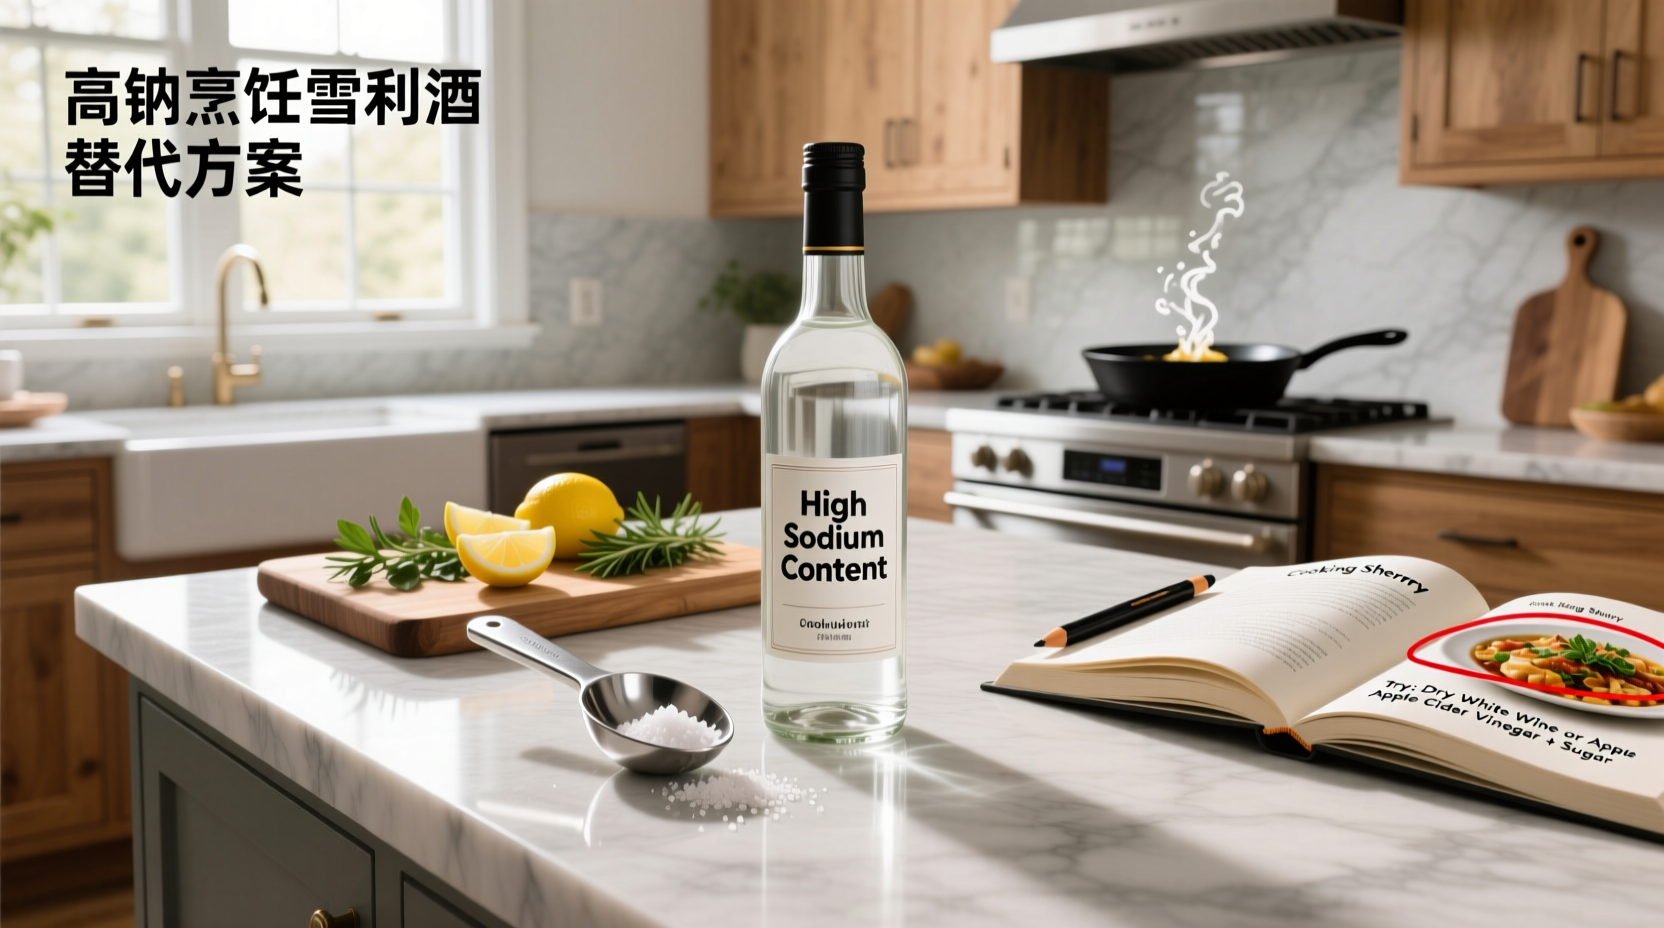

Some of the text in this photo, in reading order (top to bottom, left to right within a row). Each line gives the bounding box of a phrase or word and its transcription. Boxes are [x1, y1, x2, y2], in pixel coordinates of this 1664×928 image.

[801, 489, 867, 523] High
[783, 522, 884, 550] Sodium
[781, 554, 888, 582] Content
[1287, 564, 1357, 577] Cooking
[1385, 680, 1417, 692] Try:
[1421, 685, 1456, 700] Dry
[1461, 693, 1510, 716] White
[1516, 712, 1559, 733] Wine
[1564, 731, 1584, 741] or
[1368, 690, 1419, 702] Apple
[1560, 741, 1613, 764] Sugar
